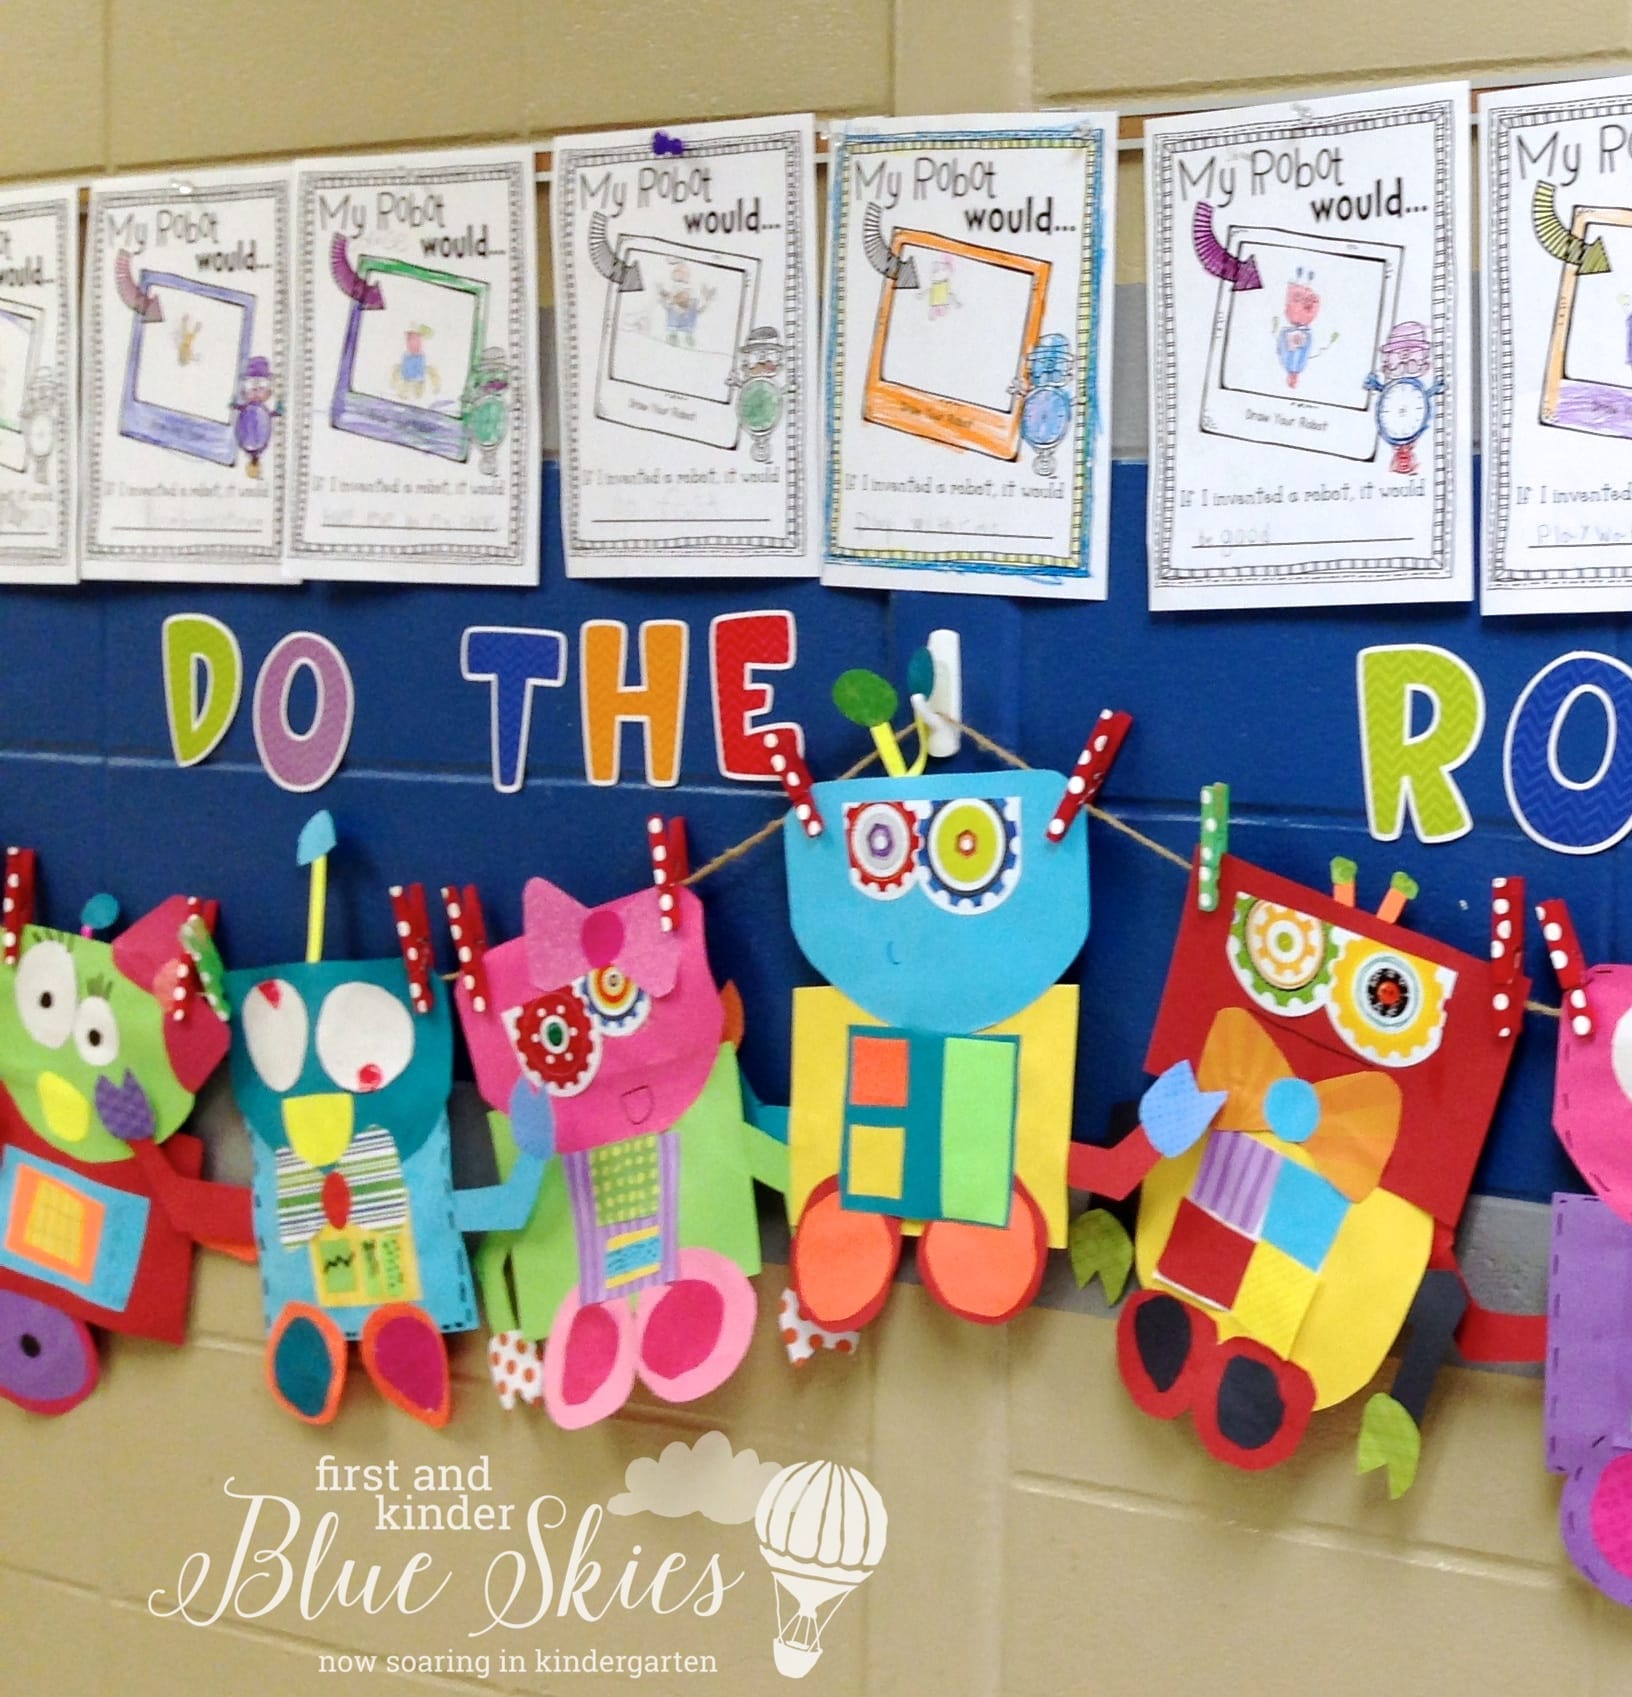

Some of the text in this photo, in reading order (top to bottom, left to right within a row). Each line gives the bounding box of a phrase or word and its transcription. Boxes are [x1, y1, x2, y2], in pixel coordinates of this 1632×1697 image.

[855, 156, 998, 210] My Robot
[1178, 147, 1344, 209] My Robot
[1516, 131, 1581, 187] My
[319, 191, 446, 239] My Robot
[579, 166, 713, 219] My Robot
[964, 195, 1077, 236] would...
[1310, 176, 1428, 223] would...
[845, 473, 857, 491] If
[871, 475, 933, 494] invented
[1021, 481, 1065, 499] would
[1180, 490, 1195, 508] If
[1212, 485, 1284, 506] invented
[1378, 478, 1426, 498] would
[1516, 486, 1532, 505] If
[1540, 485, 1548, 504] I
[1552, 482, 1632, 504] invented
[161, 613, 355, 792] DO
[460, 610, 806, 793] THE
